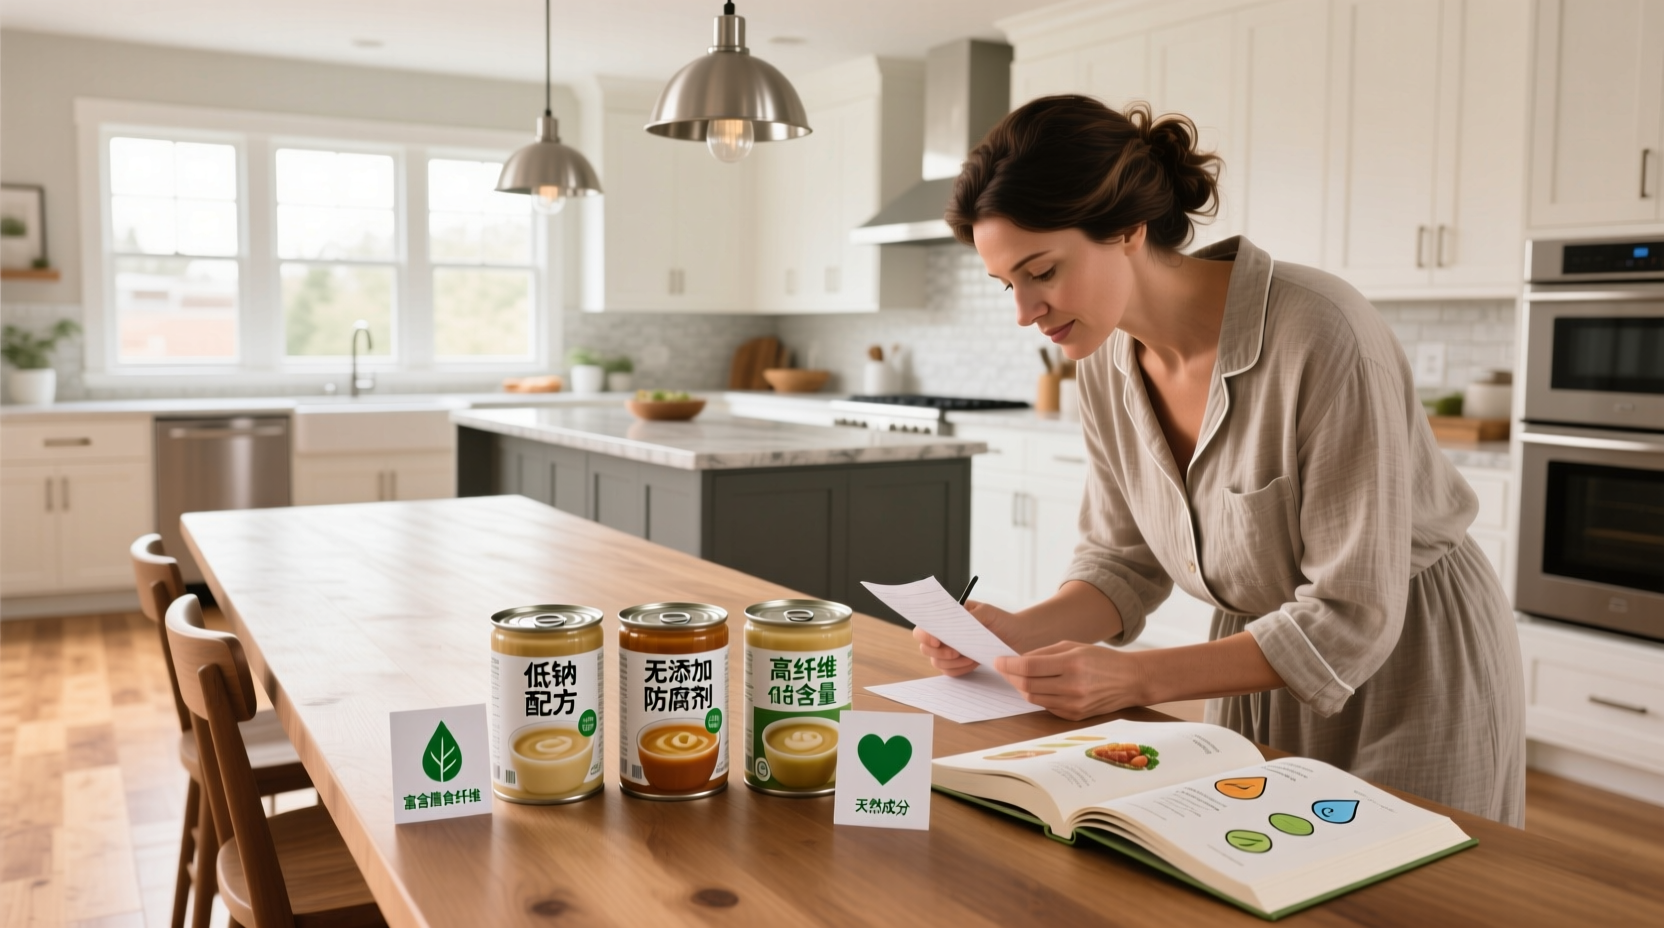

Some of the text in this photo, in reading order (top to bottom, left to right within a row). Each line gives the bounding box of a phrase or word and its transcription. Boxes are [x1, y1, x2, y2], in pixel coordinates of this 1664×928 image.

[524, 660, 577, 688] 低钠
[644, 658, 712, 683] 无添加
[769, 655, 837, 682] 高纤维
[525, 689, 577, 717] 配方
[644, 684, 712, 712] 防腐剂
[855, 798, 910, 816] 天然成分
